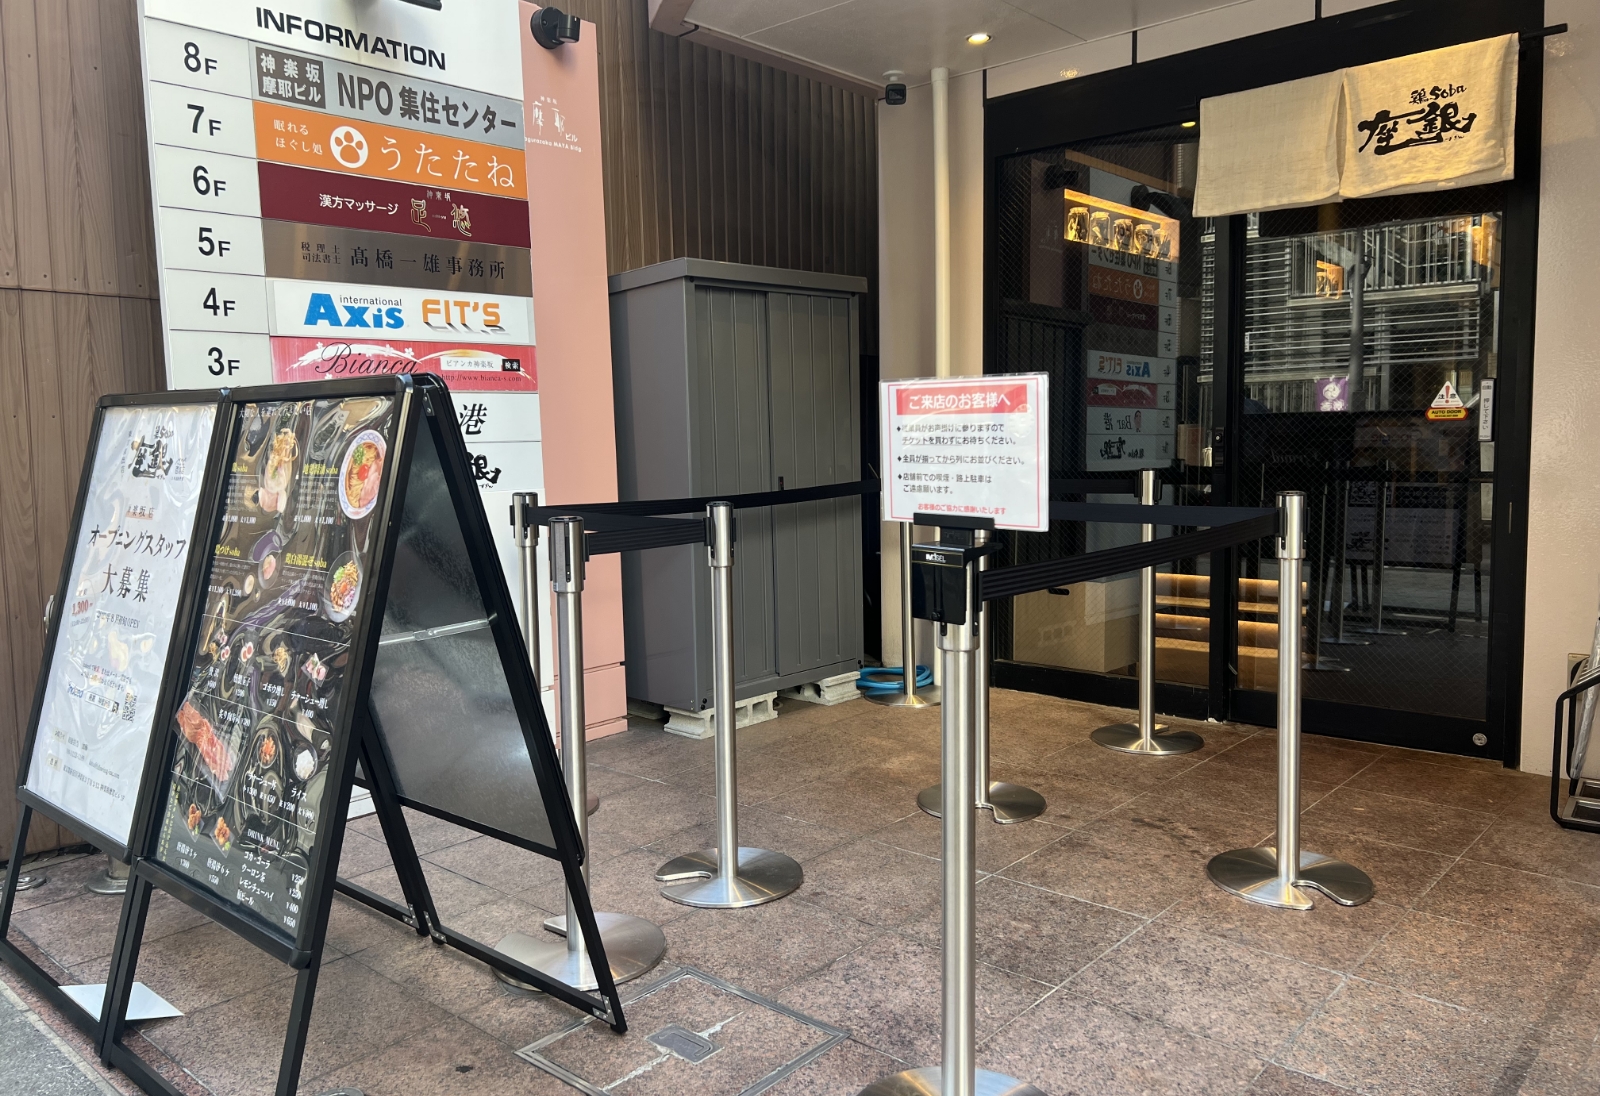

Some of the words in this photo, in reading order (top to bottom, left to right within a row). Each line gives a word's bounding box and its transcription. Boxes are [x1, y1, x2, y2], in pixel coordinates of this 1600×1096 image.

[256, 7, 446, 71] INFORMATION
[183, 41, 218, 75] 8F
[260, 52, 321, 84] 神楽坂
[262, 76, 322, 103] 摩耶ビル
[187, 103, 222, 136] 7F
[273, 119, 309, 136] 眠れる
[275, 137, 323, 155] ほぐし処
[381, 135, 515, 188] うたたね
[192, 165, 227, 197] 6F
[319, 193, 399, 215] 漢方マッサージ
[198, 226, 231, 257] 5F
[301, 241, 341, 255] 税理士
[302, 253, 342, 265] 司法書士
[203, 287, 236, 317] 4F
[339, 294, 402, 307] international
[208, 347, 240, 376] 3F
[314, 341, 418, 375] Bianca
[909, 391, 1011, 410] ご来店のお客様へ
[902, 436, 1017, 445] チケットを買わずにお待ちください。
[902, 454, 1026, 465] 全員が揃ってから列にお並びください。
[88, 523, 186, 560] オープニングスタッフ
[101, 563, 151, 603] 大募集
[291, 786, 307, 802] ライス
